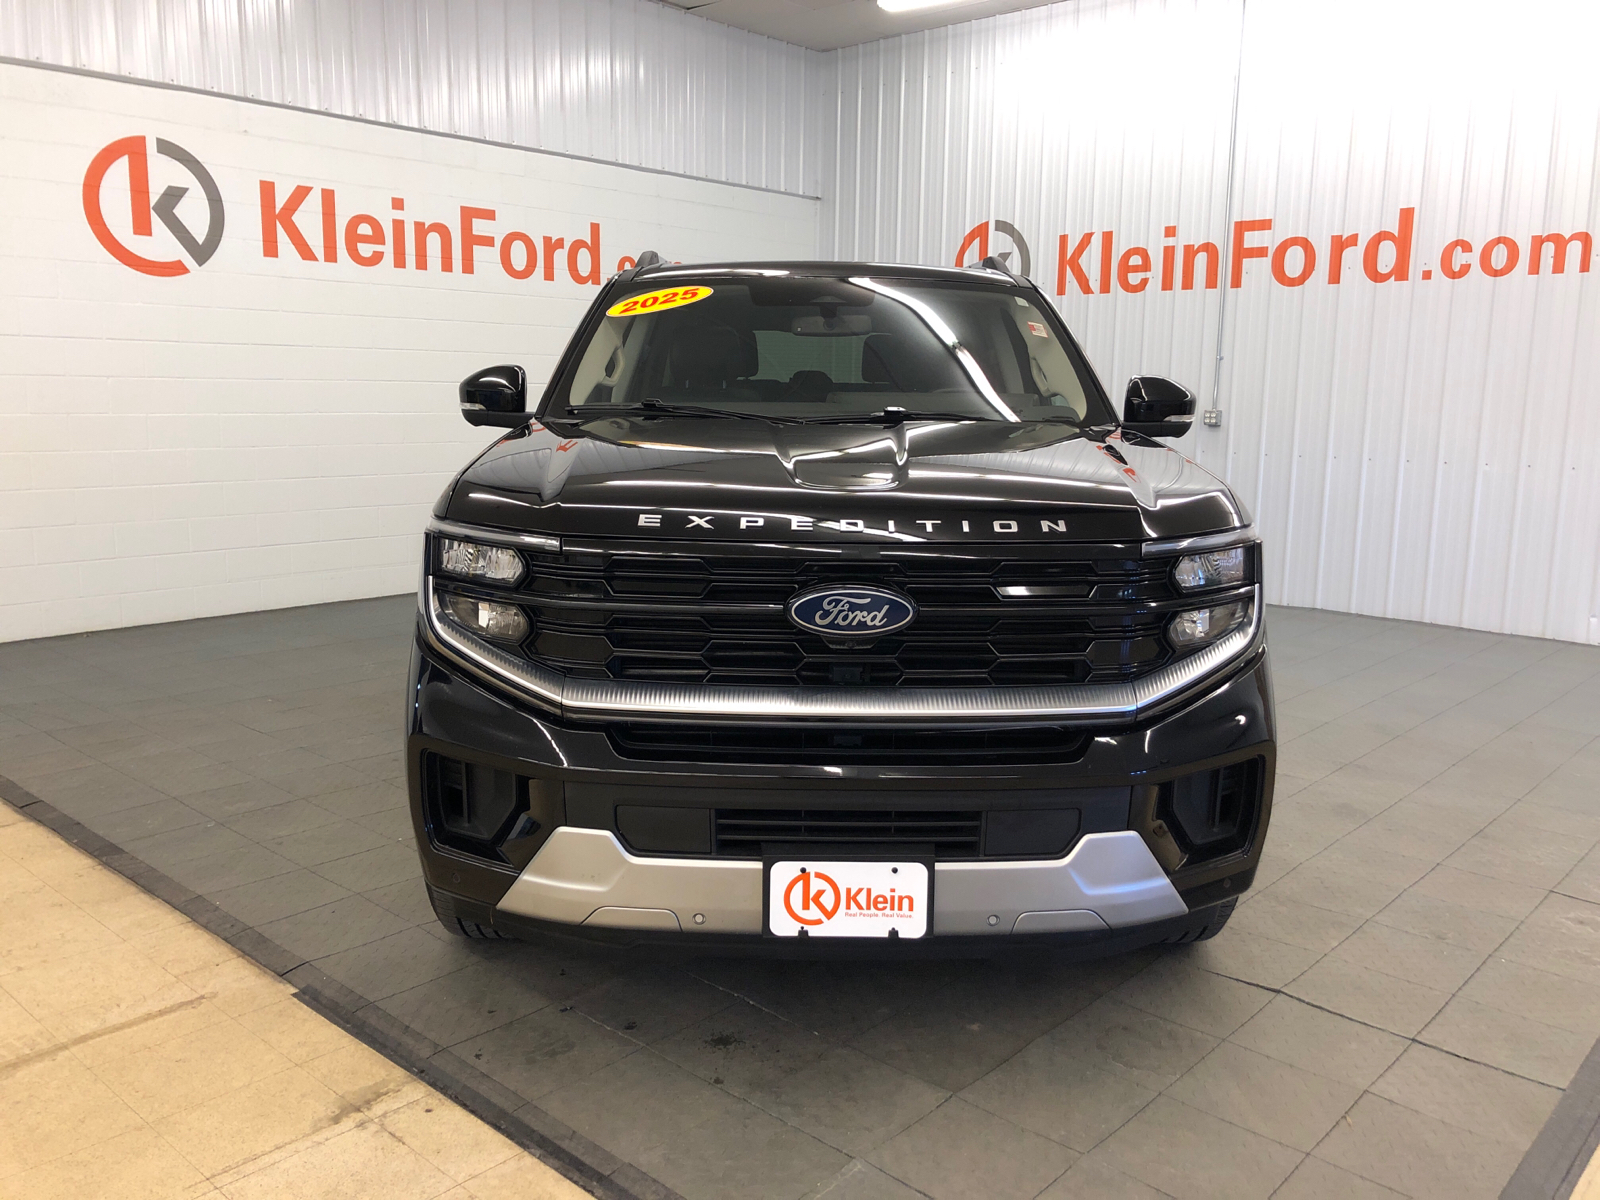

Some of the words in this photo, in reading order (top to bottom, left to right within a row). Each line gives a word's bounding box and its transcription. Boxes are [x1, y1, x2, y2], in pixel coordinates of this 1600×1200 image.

[1056, 207, 1593, 296] KleinFord.com
[619, 287, 700, 315] 2025
[637, 513, 1068, 535] EXPEDITION
[814, 595, 888, 628] Ford
[845, 887, 914, 912] Klein
[859, 911, 881, 919] People.
